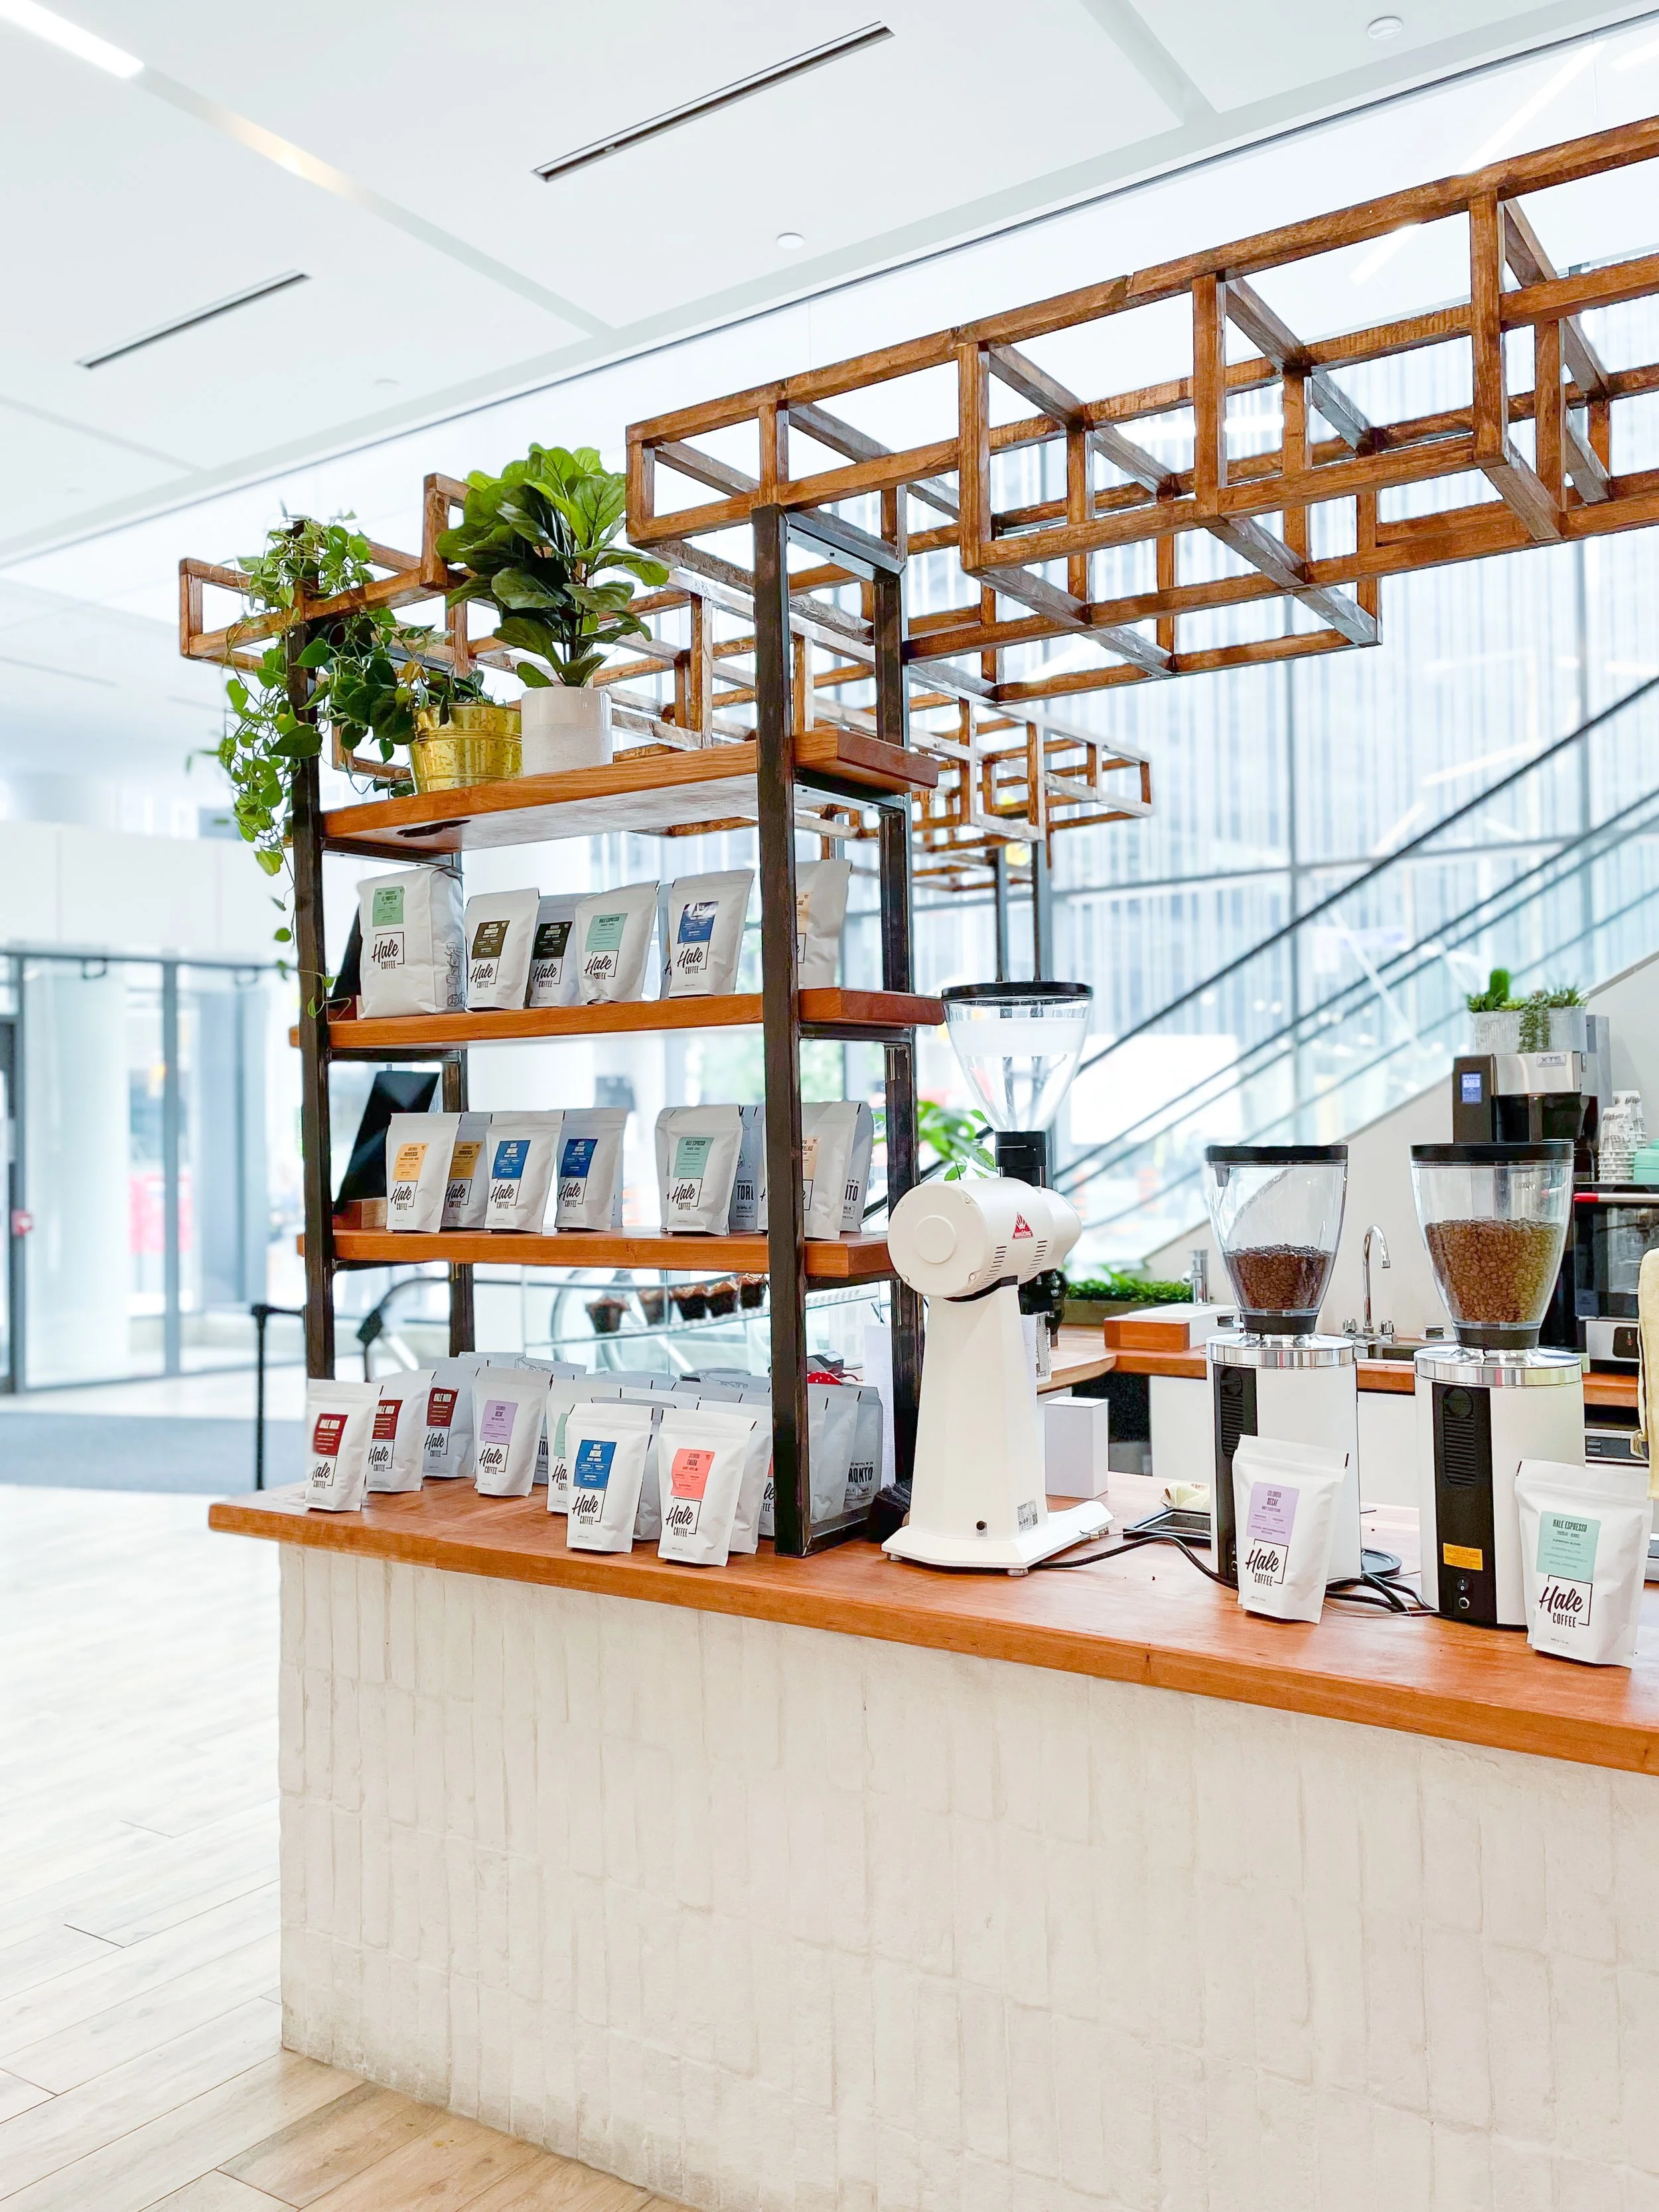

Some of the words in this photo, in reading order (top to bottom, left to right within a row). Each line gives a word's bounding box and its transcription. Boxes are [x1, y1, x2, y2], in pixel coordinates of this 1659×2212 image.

[371, 939, 399, 963] Hale
[677, 947, 703, 968] Hale
[382, 960, 396, 970] COFFEE
[470, 963, 493, 983] Hale
[532, 963, 557, 982] Hale
[584, 955, 612, 975] Hale
[685, 966, 699, 974] COFFEE
[391, 1186, 413, 1205] Hale
[445, 1184, 467, 1203] Hale
[491, 1184, 514, 1203] Hale
[559, 1182, 581, 1201] Hale
[671, 1183, 696, 1204] Hale
[424, 1433, 445, 1451] Hale
[368, 1446, 389, 1465] Hale
[478, 1447, 503, 1467] Hale
[484, 1466, 498, 1475] COFFEE
[313, 1480, 326, 1489] COFFEE
[572, 1495, 599, 1516] Hale
[579, 1515, 594, 1525] COFFEE
[666, 1505, 694, 1528] Hale
[1552, 1519, 1565, 1529] HALE
[1564, 1520, 1588, 1532] ESPRESSO
[673, 1526, 688, 1538] COFFEE
[1245, 1548, 1279, 1574] Hale
[1254, 1573, 1273, 1587] COFFEE
[1539, 1585, 1583, 1613] Hale
[1553, 1612, 1577, 1628] COFFEE
